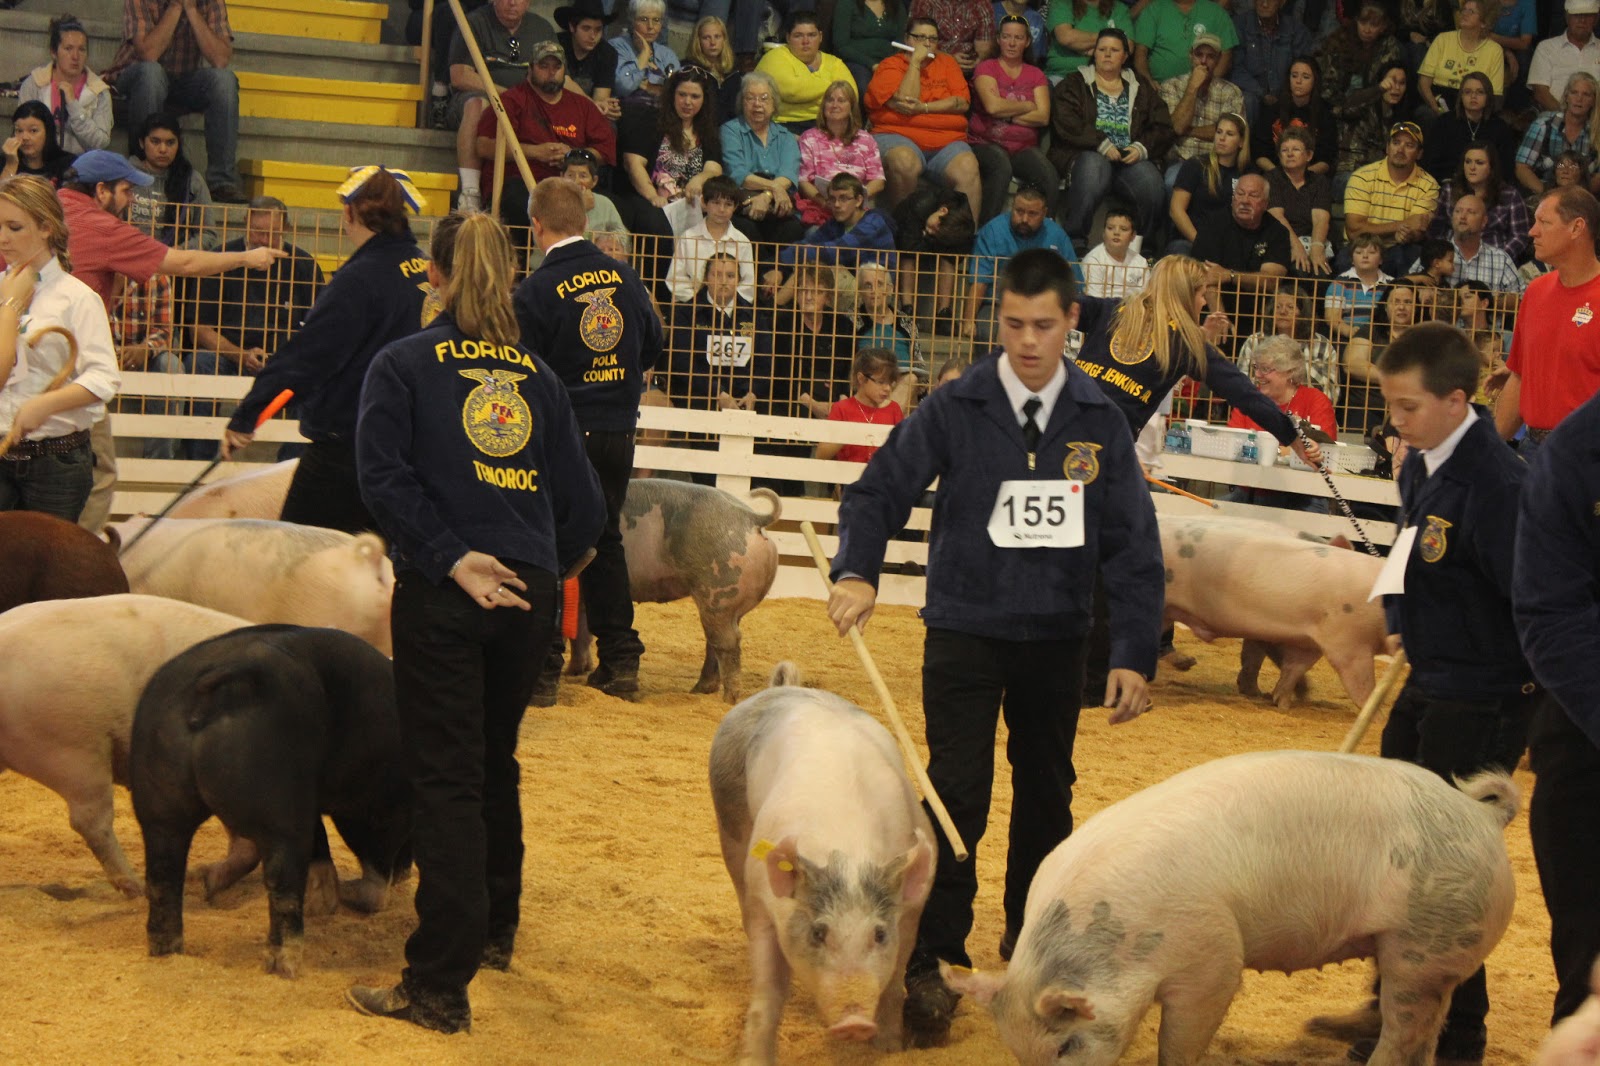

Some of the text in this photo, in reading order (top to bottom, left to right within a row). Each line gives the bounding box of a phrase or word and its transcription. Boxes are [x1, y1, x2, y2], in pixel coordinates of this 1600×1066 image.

[556, 270, 623, 299] FLORIDA
[434, 339, 538, 373] FLORIDA
[592, 354, 618, 368] POLK
[712, 341, 746, 358] 267
[583, 368, 625, 382] COUNTY
[1101, 367, 1143, 396] JENKINS
[491, 402, 514, 419] FFA
[472, 460, 538, 492] TENOROC
[1003, 495, 1066, 526] 155
